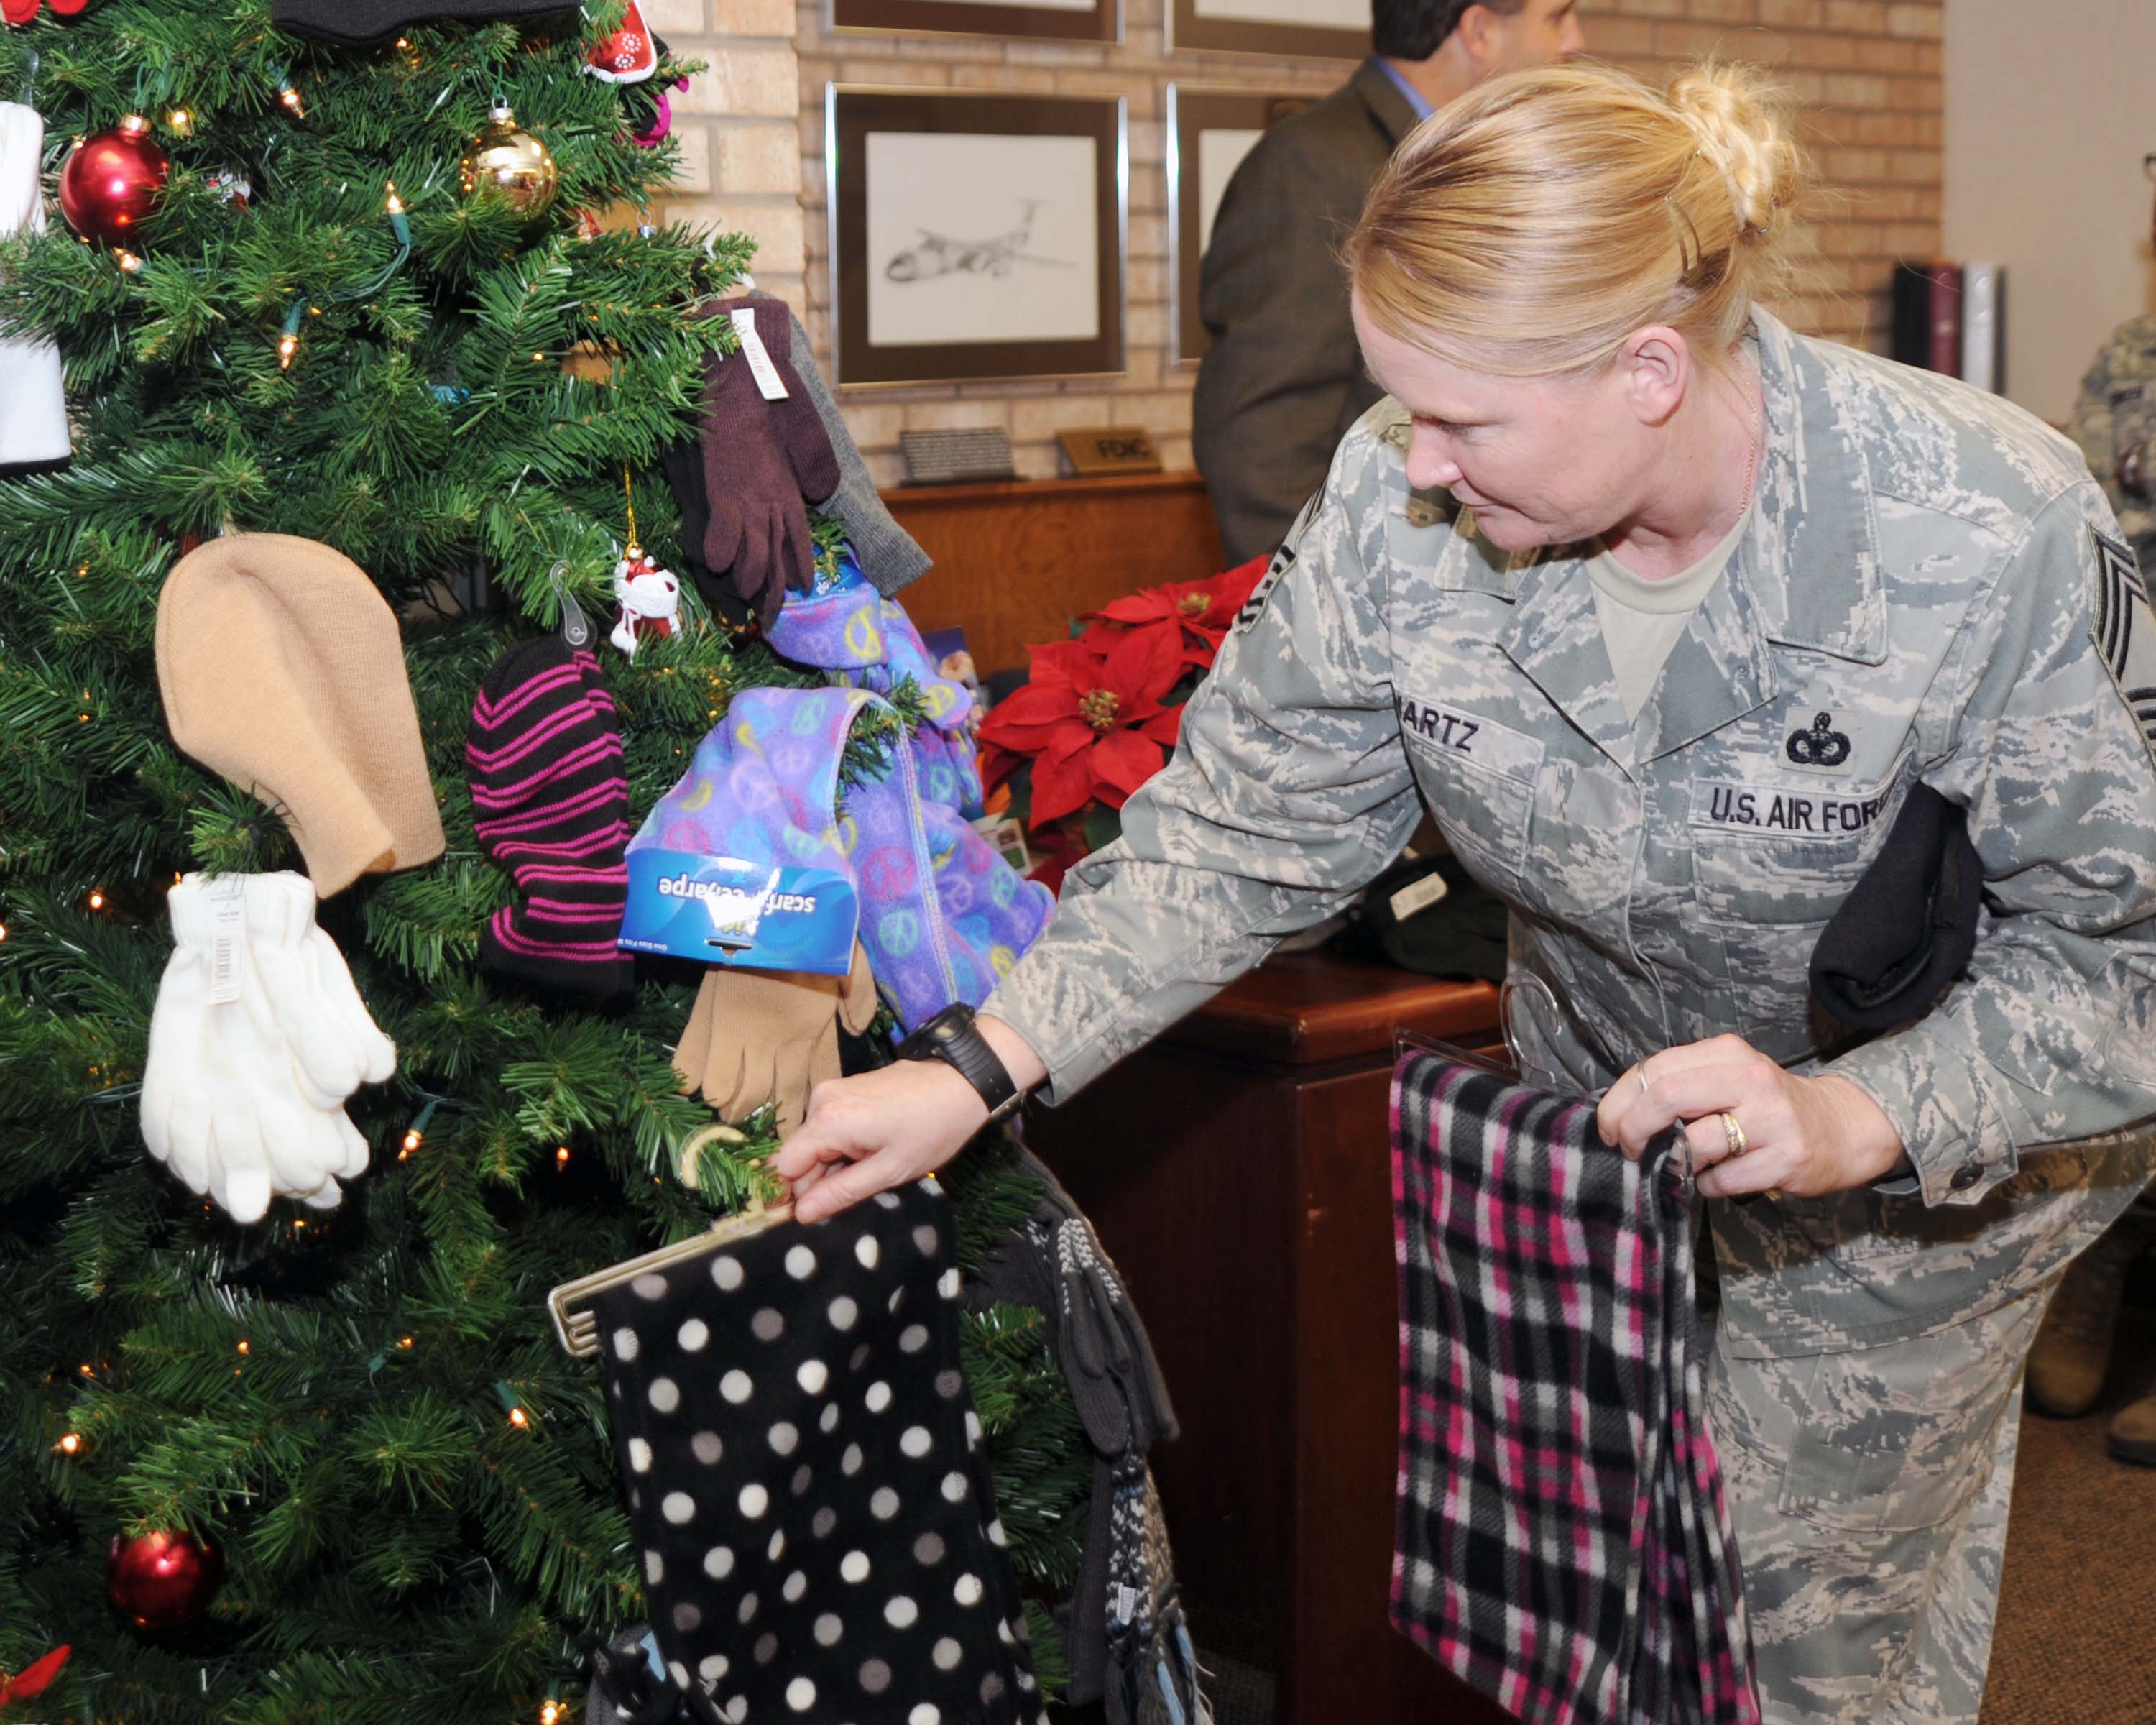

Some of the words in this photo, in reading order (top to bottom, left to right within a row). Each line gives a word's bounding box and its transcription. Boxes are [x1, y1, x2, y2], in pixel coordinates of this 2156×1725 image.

[1398, 696, 1480, 753] ARTZ
[1710, 787, 1761, 827] U.S.
[1766, 794, 1815, 832] AIR
[765, 893, 816, 916] scarf
